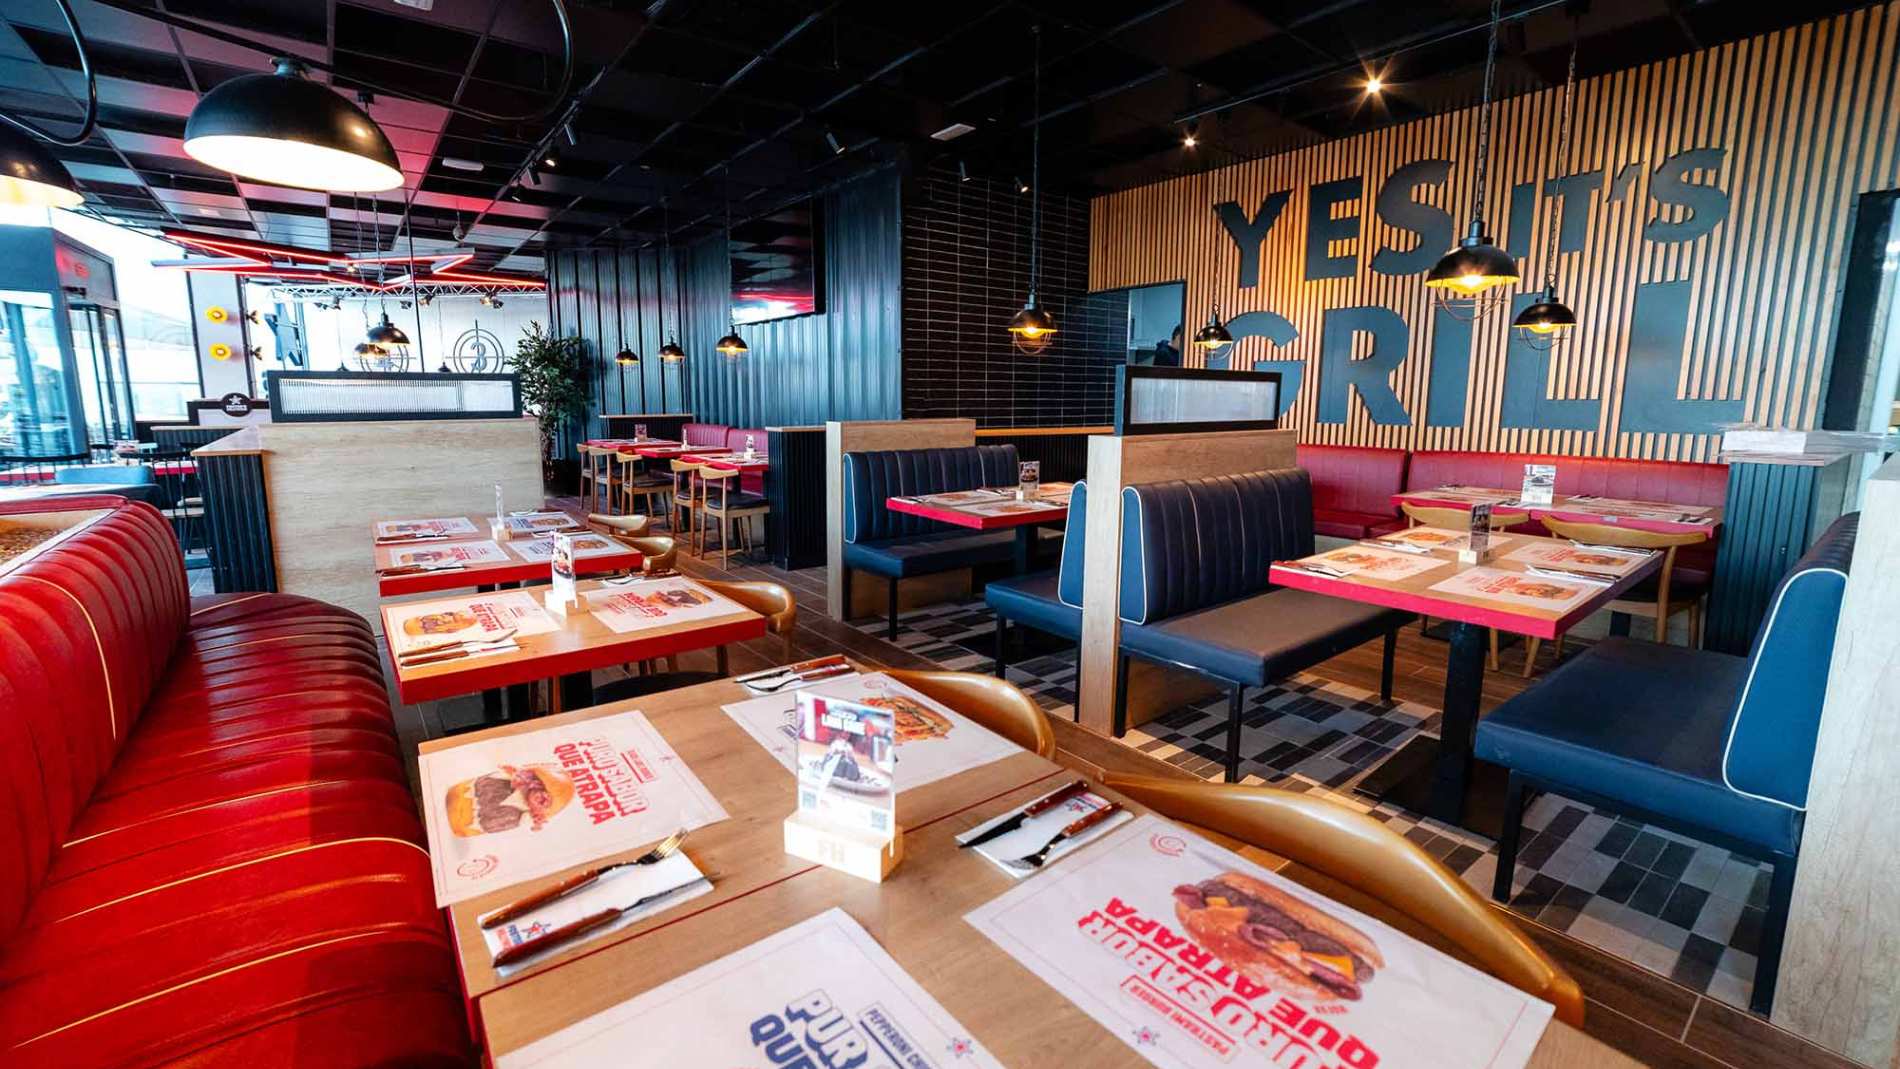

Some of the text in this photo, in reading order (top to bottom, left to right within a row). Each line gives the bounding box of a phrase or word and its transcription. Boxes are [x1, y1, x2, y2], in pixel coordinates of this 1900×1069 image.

[1213, 147, 1729, 288] YES IT'S
[1202, 281, 1746, 432] GRILL
[554, 743, 617, 825] QUE ATRAPA
[785, 988, 869, 1069] PUR
[1078, 910, 1346, 1069] URO SABOR
[1105, 897, 1379, 1069] QUE ATRAPA
